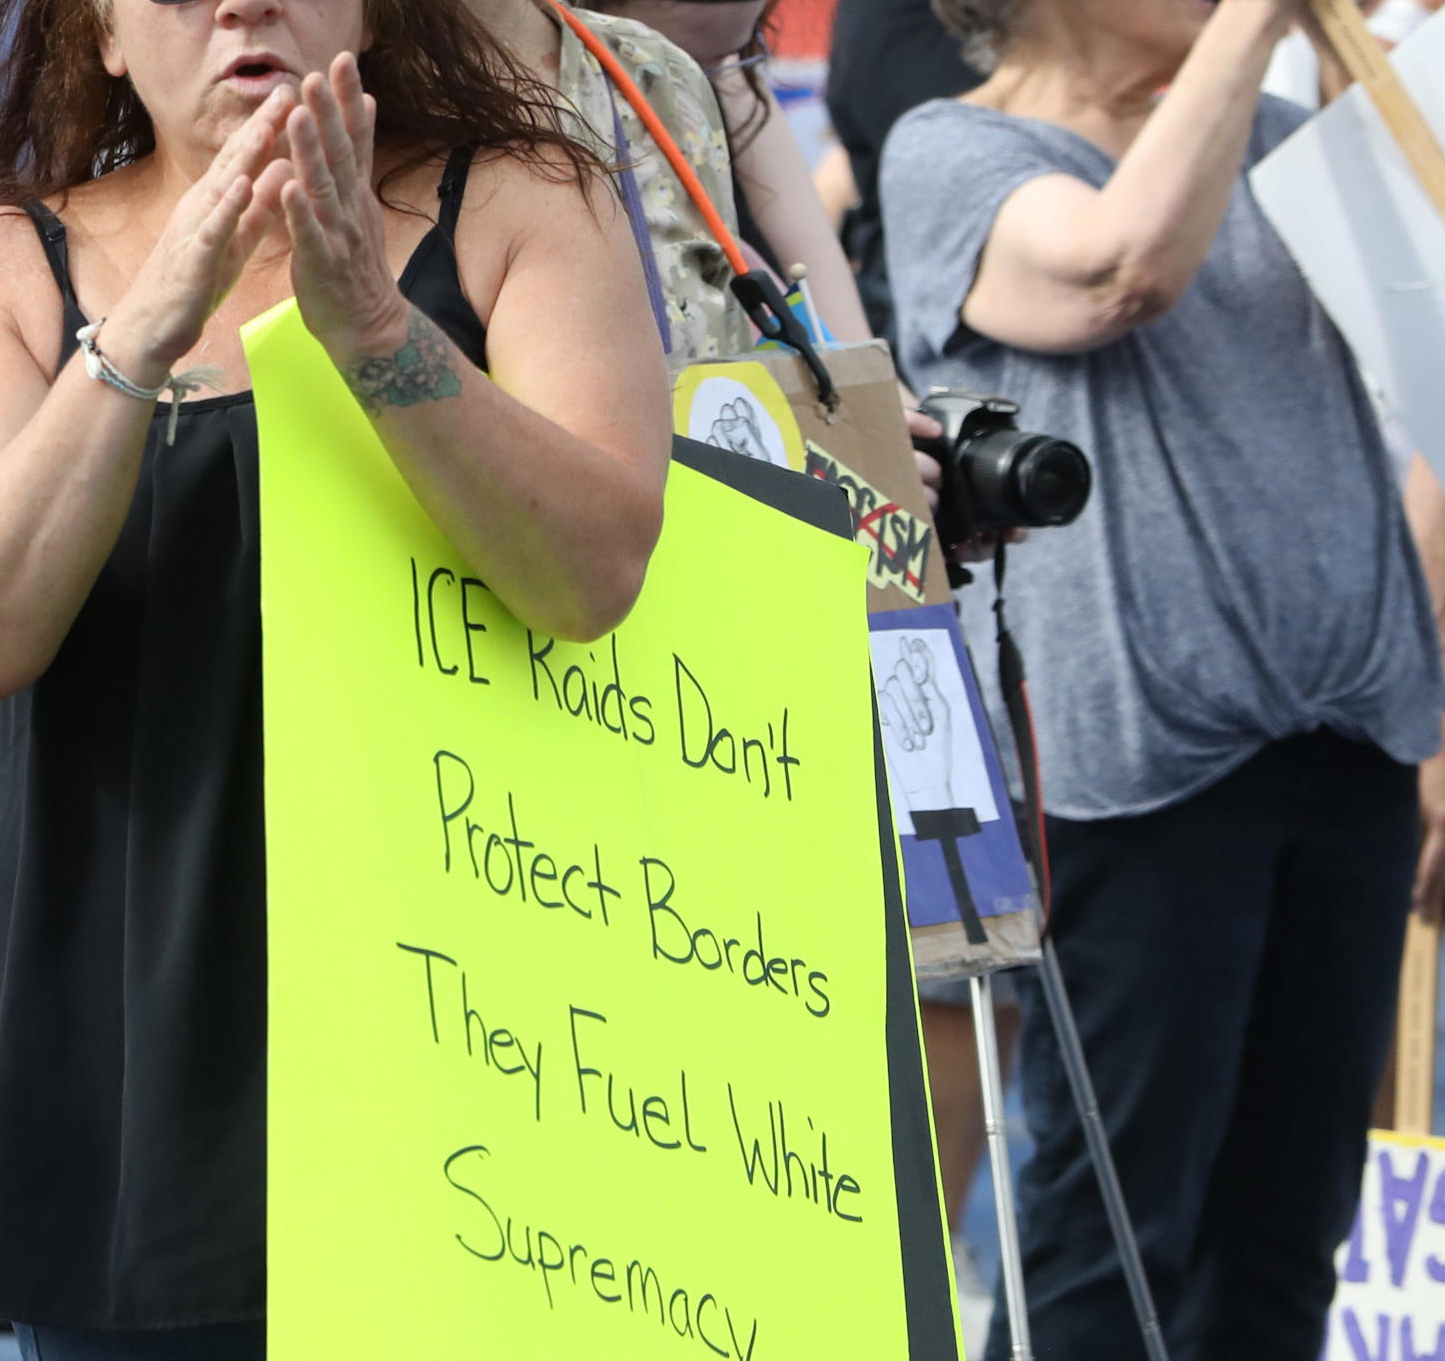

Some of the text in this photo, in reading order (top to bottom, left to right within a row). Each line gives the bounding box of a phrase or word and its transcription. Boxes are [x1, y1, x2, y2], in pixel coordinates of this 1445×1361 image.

[411, 556, 802, 803] ICE Raids Don't
[433, 749, 831, 1018] Protect Borders
[395, 940, 865, 1225] They Fuel White
[443, 1144, 759, 1361] Supremacy
